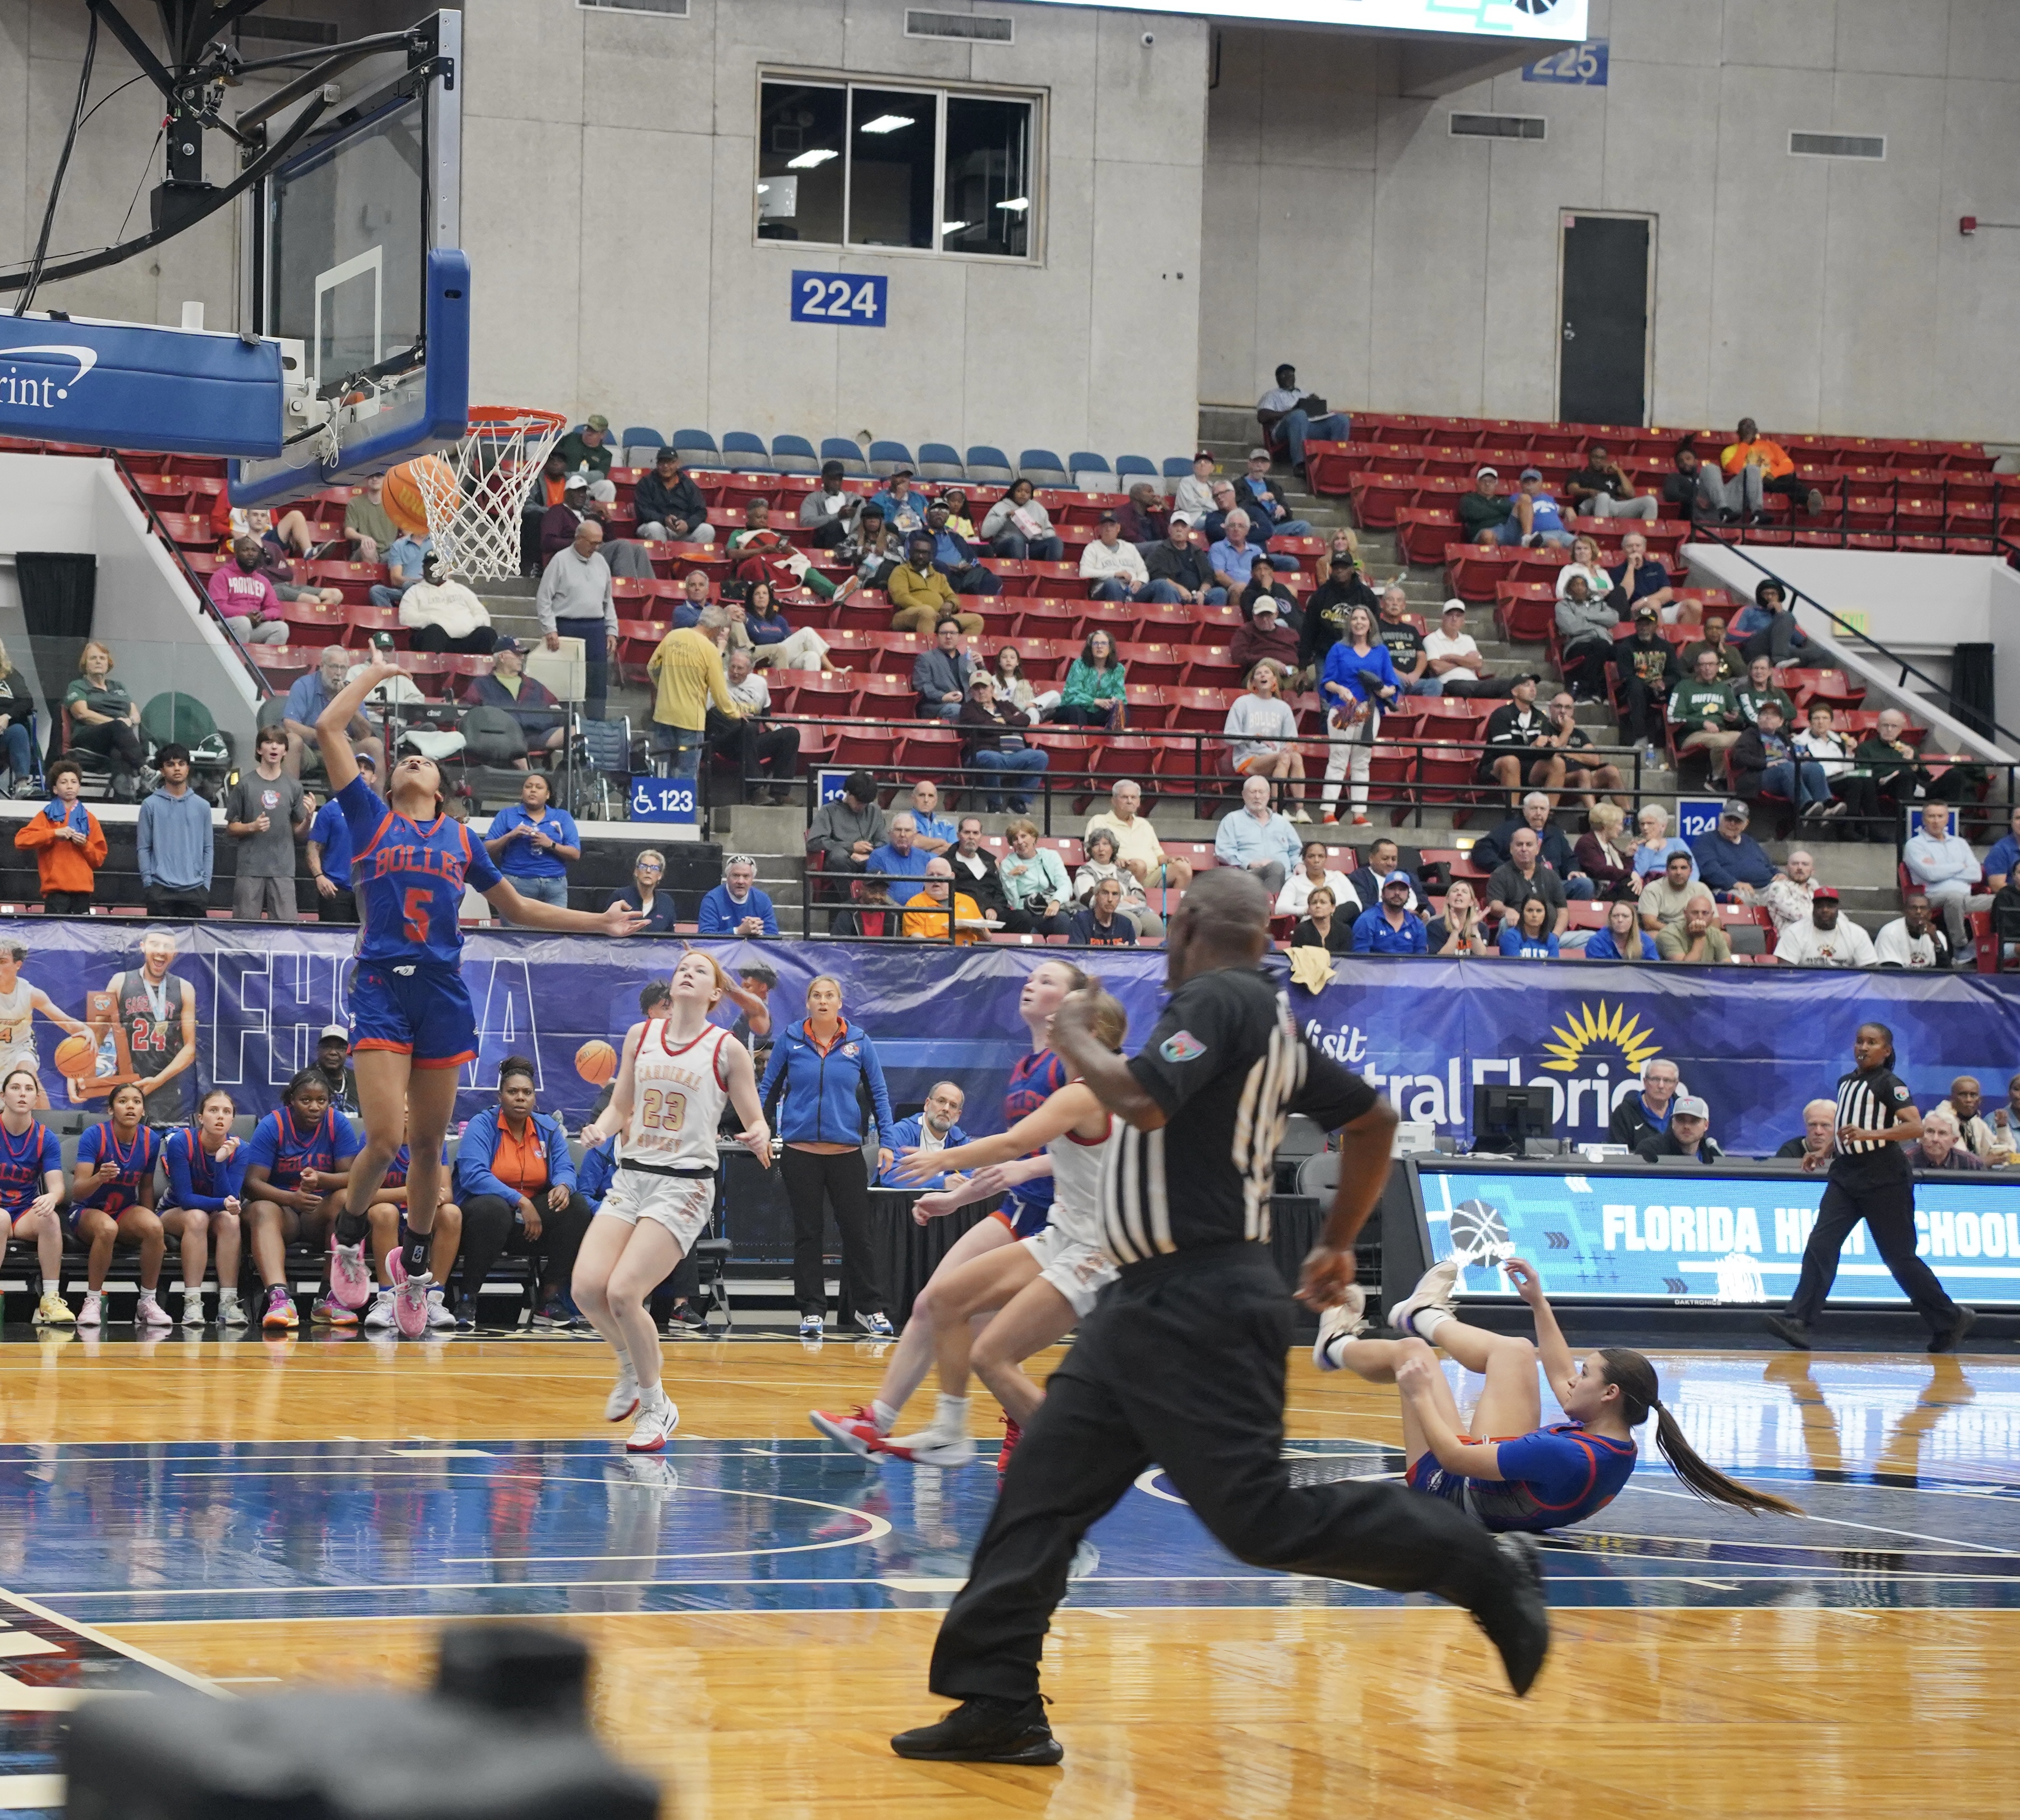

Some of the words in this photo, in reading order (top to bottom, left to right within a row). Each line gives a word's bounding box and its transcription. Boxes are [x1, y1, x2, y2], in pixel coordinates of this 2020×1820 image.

[802, 278, 878, 318] 224
[659, 790, 693, 812] 123
[825, 789, 847, 802] 12
[1683, 816, 1716, 836] 124
[374, 844, 463, 891] BOLLES
[404, 887, 434, 942] 5
[132, 1018, 166, 1051] 24
[643, 1088, 687, 1132] 23
[1360, 1057, 1465, 1125] tral
[1602, 1204, 1763, 1253] FLORIDA
[1774, 1208, 1866, 1256] HIH
[1913, 1210, 2020, 1257] CHOOL
